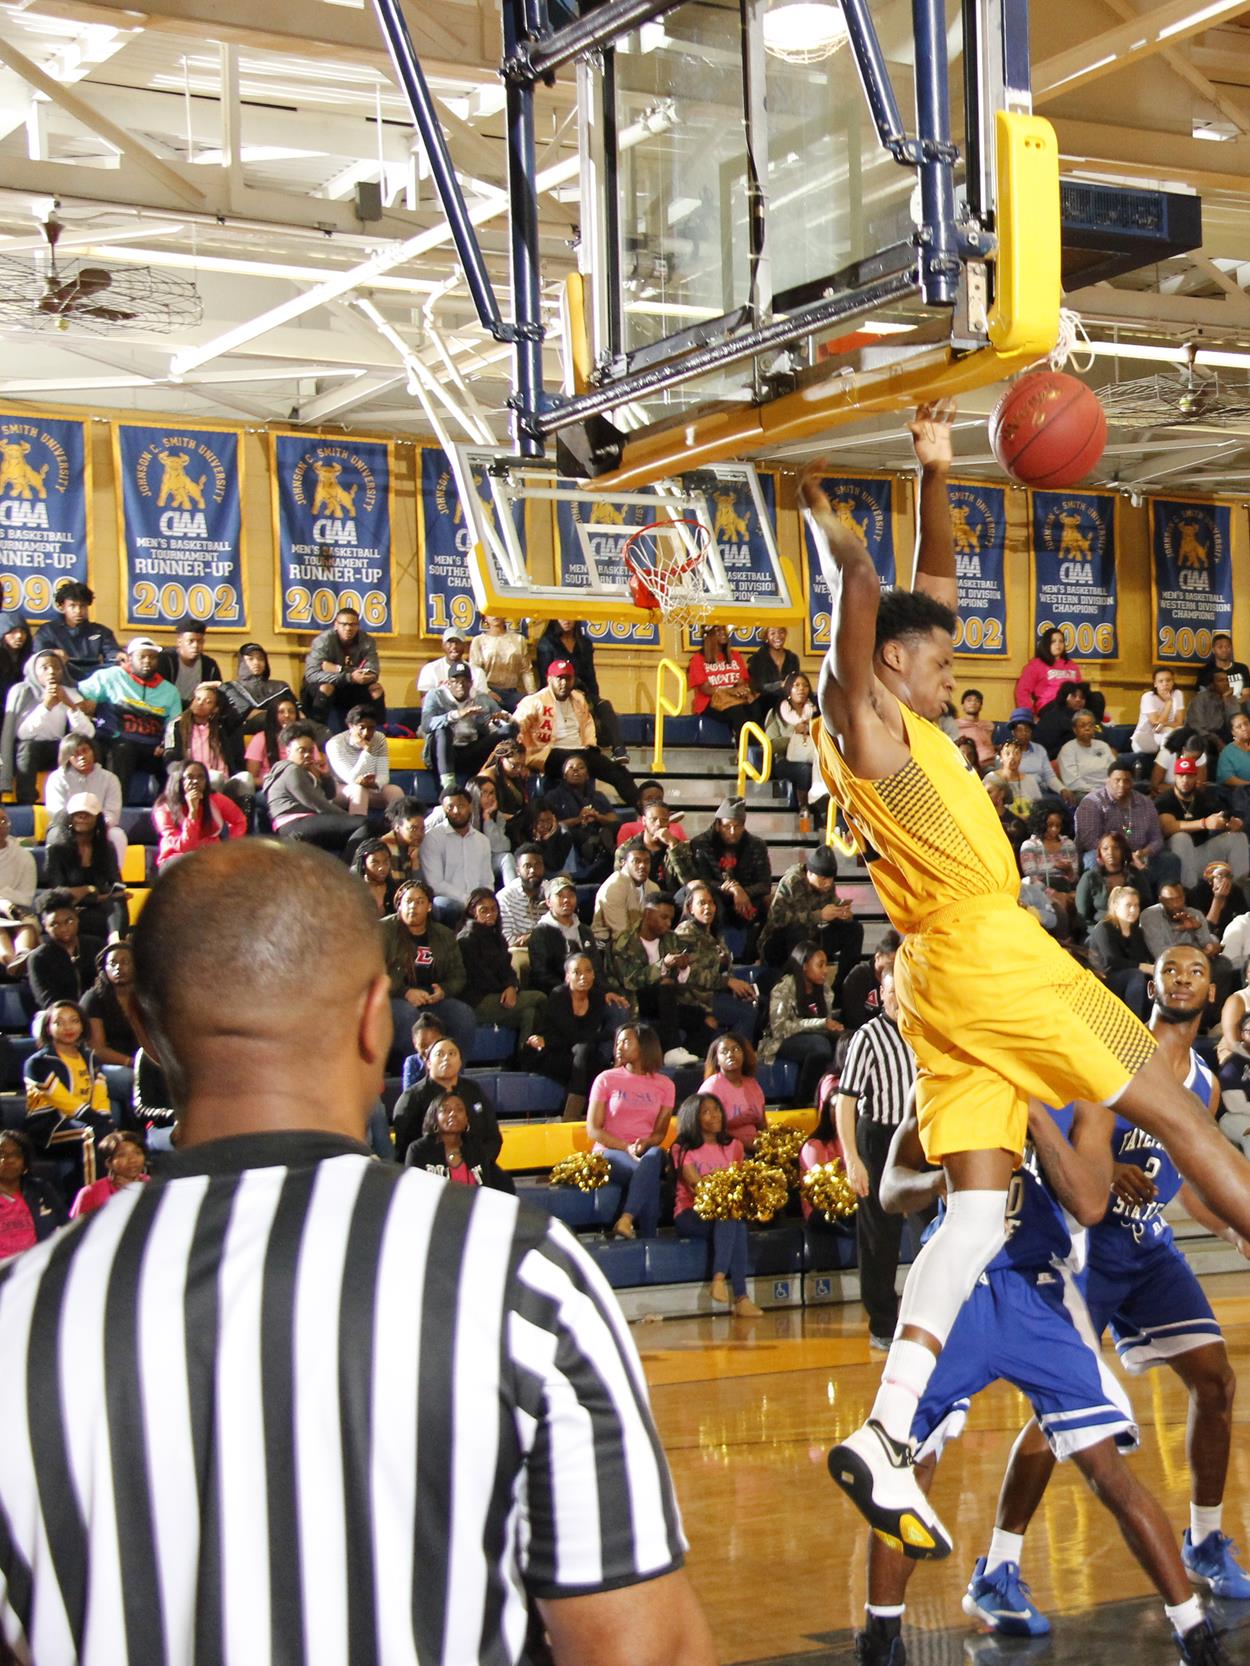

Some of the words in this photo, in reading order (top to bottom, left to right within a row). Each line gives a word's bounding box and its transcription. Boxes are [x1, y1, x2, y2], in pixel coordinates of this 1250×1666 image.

[1, 424, 39, 437] SMITH
[40, 432, 70, 494] UNIVERSITY
[136, 451, 152, 497] JOHNSON
[163, 436, 197, 449] SMITH
[198, 445, 227, 504] UNIVERSITY
[292, 461, 307, 505] JOHNSON
[317, 447, 348, 459] SMITH
[350, 455, 377, 513] UNIVERSITY
[436, 472, 450, 515] JOHNSON
[861, 491, 884, 542] UNIVERSITY
[950, 491, 975, 503] SMITH
[976, 499, 996, 548] UNIVERSITY
[8, 529, 75, 543] BASKETBALL
[0, 539, 62, 553] URNAMENT
[136, 537, 168, 549] MEN'S
[170, 539, 232, 551] BASKETBALL
[291, 544, 320, 555] MEN'S
[322, 545, 381, 558] BASKETBALL
[0, 550, 77, 568] NNER-UP
[150, 549, 219, 562] TOURNAMENT
[303, 555, 369, 568] TOURNAMENT
[434, 555, 461, 565] MEN'S
[135, 559, 234, 577] RUNNER-UP
[289, 564, 383, 583] RUNNER-UP
[429, 564, 471, 579] SOUTHER
[726, 571, 772, 581] ASKETBALL
[958, 580, 998, 589] ASKETBALL
[1042, 585, 1065, 594] MEN'S
[1066, 586, 1108, 596] BASKETBALL
[0, 572, 80, 614] 99
[968, 589, 1001, 600] DIVISION
[1040, 594, 1079, 604] WESTERN
[1080, 595, 1115, 605] DIVISION
[1162, 591, 1184, 600] MEN'S
[1185, 592, 1225, 602] BASKETBALL
[133, 580, 239, 621] 2002
[286, 586, 388, 627] 2006
[957, 599, 988, 608] MPIONS
[1160, 600, 1197, 610] WESTERN
[1198, 601, 1231, 612] DIVISION
[1052, 604, 1099, 614] CHAMPIONS
[1172, 610, 1216, 620] CHAMPIONS
[952, 615, 1003, 649] 002
[1159, 625, 1231, 658] 200
